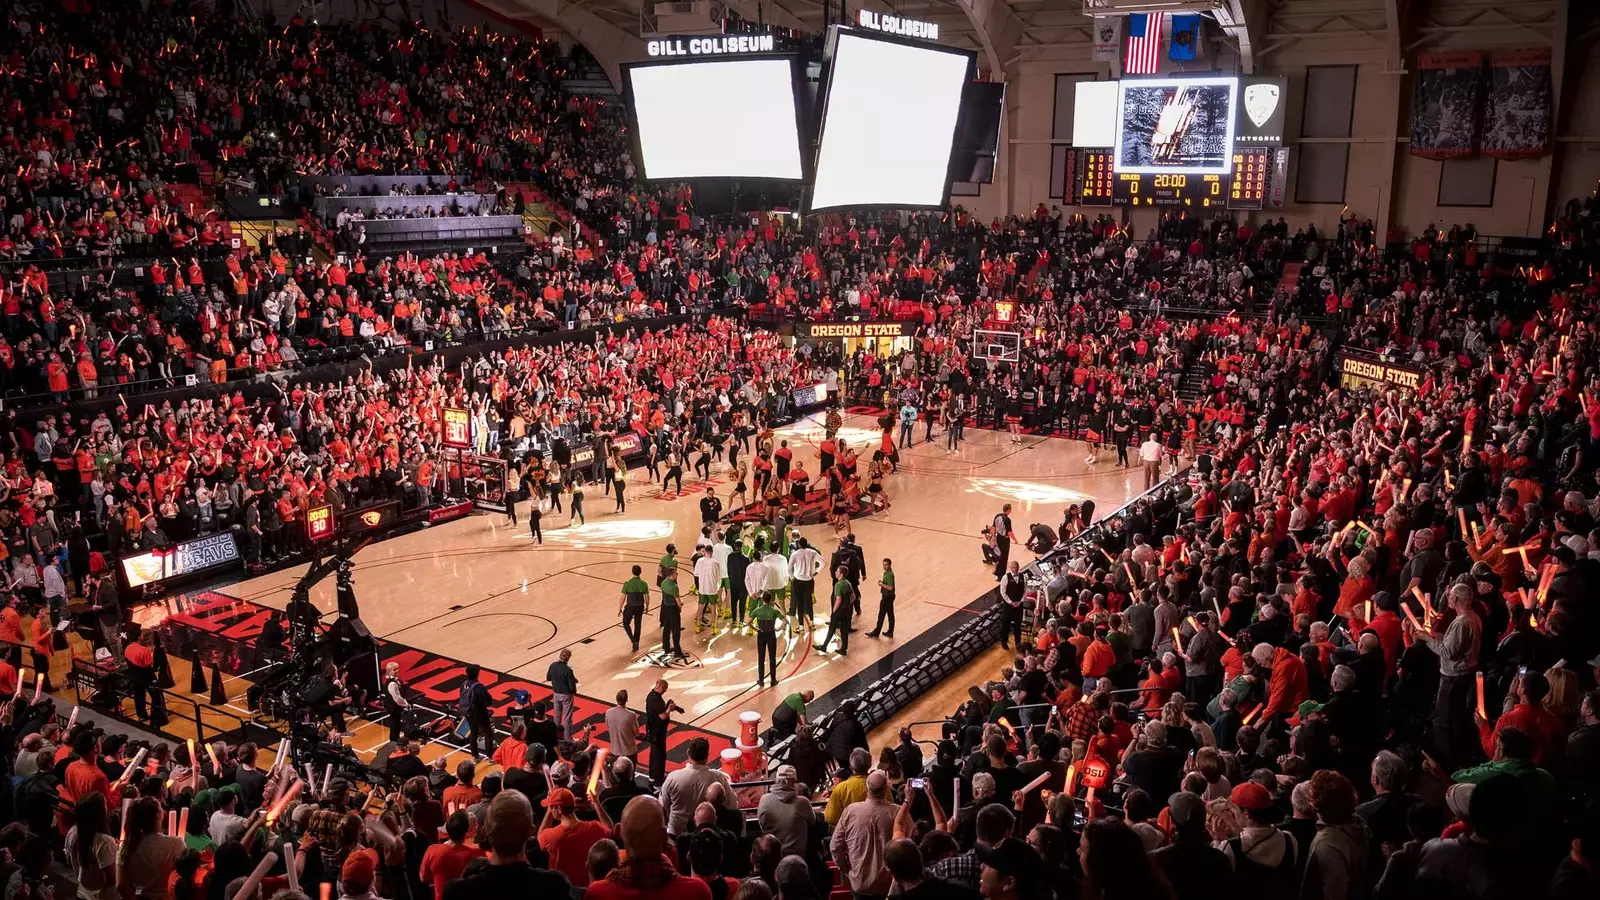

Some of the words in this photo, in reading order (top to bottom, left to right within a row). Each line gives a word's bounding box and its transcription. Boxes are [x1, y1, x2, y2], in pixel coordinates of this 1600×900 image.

[860, 9, 880, 30] GILL
[882, 14, 938, 39] COLISEUM
[648, 40, 686, 56] GILL
[690, 35, 773, 54] COLISEUM
[1233, 155, 1243, 163] 00
[1154, 175, 1186, 187] 20:00
[1131, 182, 1138, 193] 0
[1211, 182, 1219, 195] 0
[1176, 190, 1180, 198] 1
[1133, 197, 1138, 205] 0
[1204, 198, 1209, 206] 0
[811, 325, 861, 336] OREGON
[864, 324, 901, 336] STATE
[1344, 359, 1384, 379] OREGON
[1386, 368, 1419, 389] STATE
[310, 508, 328, 522] 20:00
[313, 520, 326, 533] 30
[1085, 767, 1106, 778] OSU
